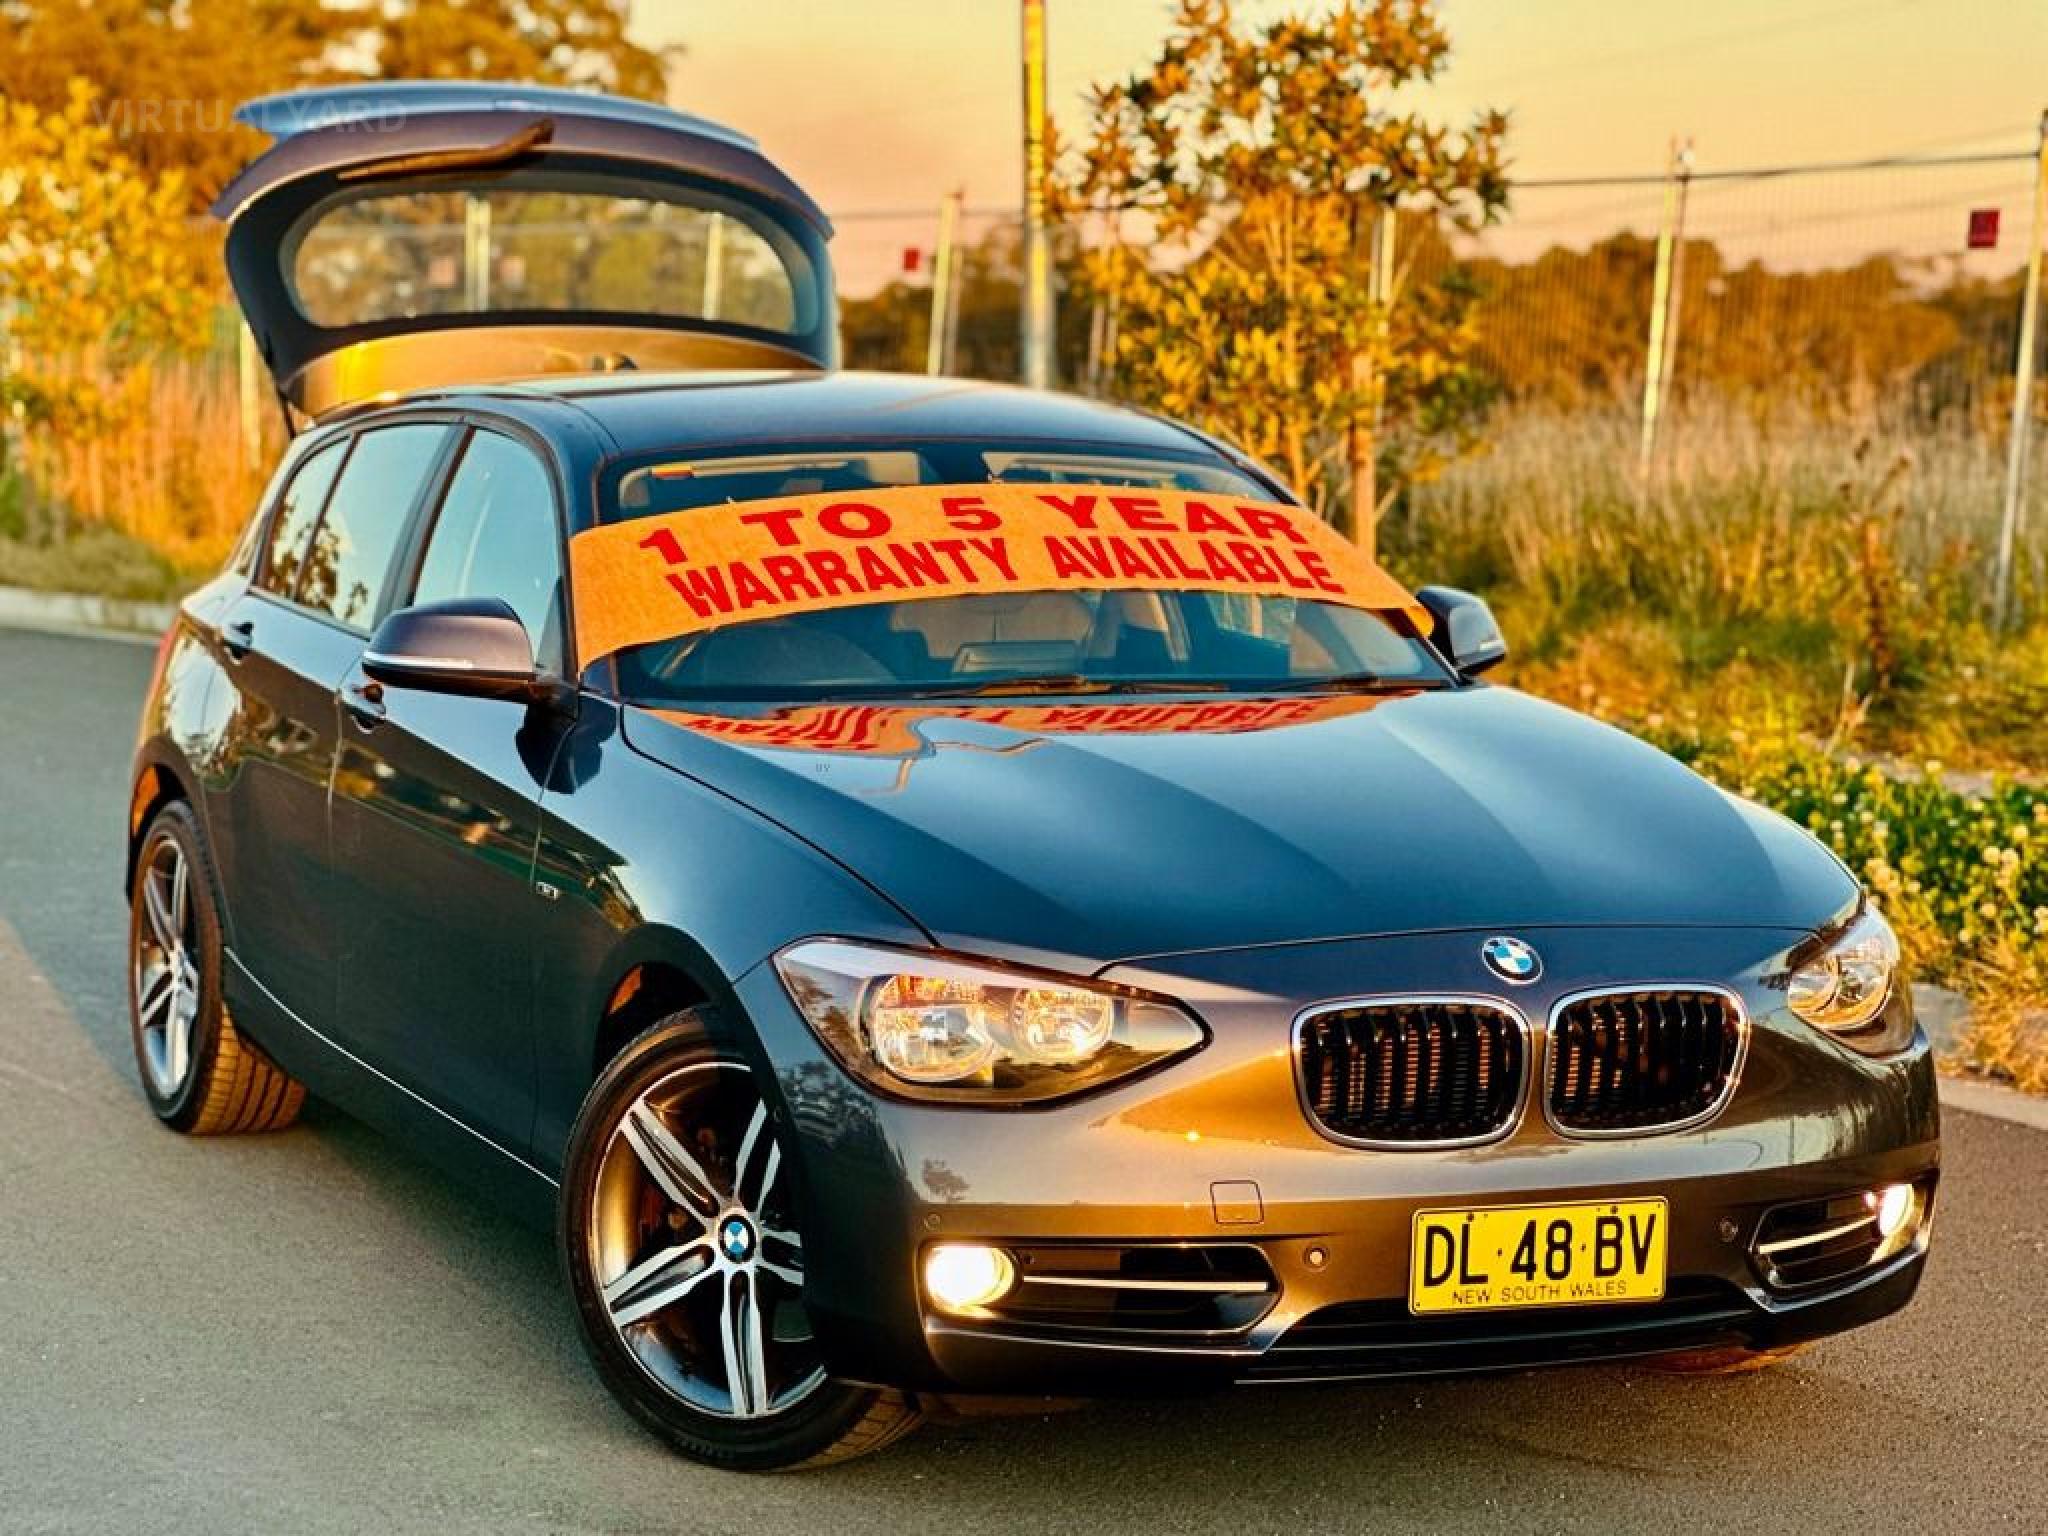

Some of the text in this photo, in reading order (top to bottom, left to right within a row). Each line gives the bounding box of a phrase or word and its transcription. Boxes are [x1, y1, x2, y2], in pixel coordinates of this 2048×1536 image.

[640, 495, 1309, 565] 1 TO 5 YEAR
[666, 536, 1346, 618] WARRANTY AVAILABLE
[1452, 1280, 1628, 1304] NEW SOUTH WALES
